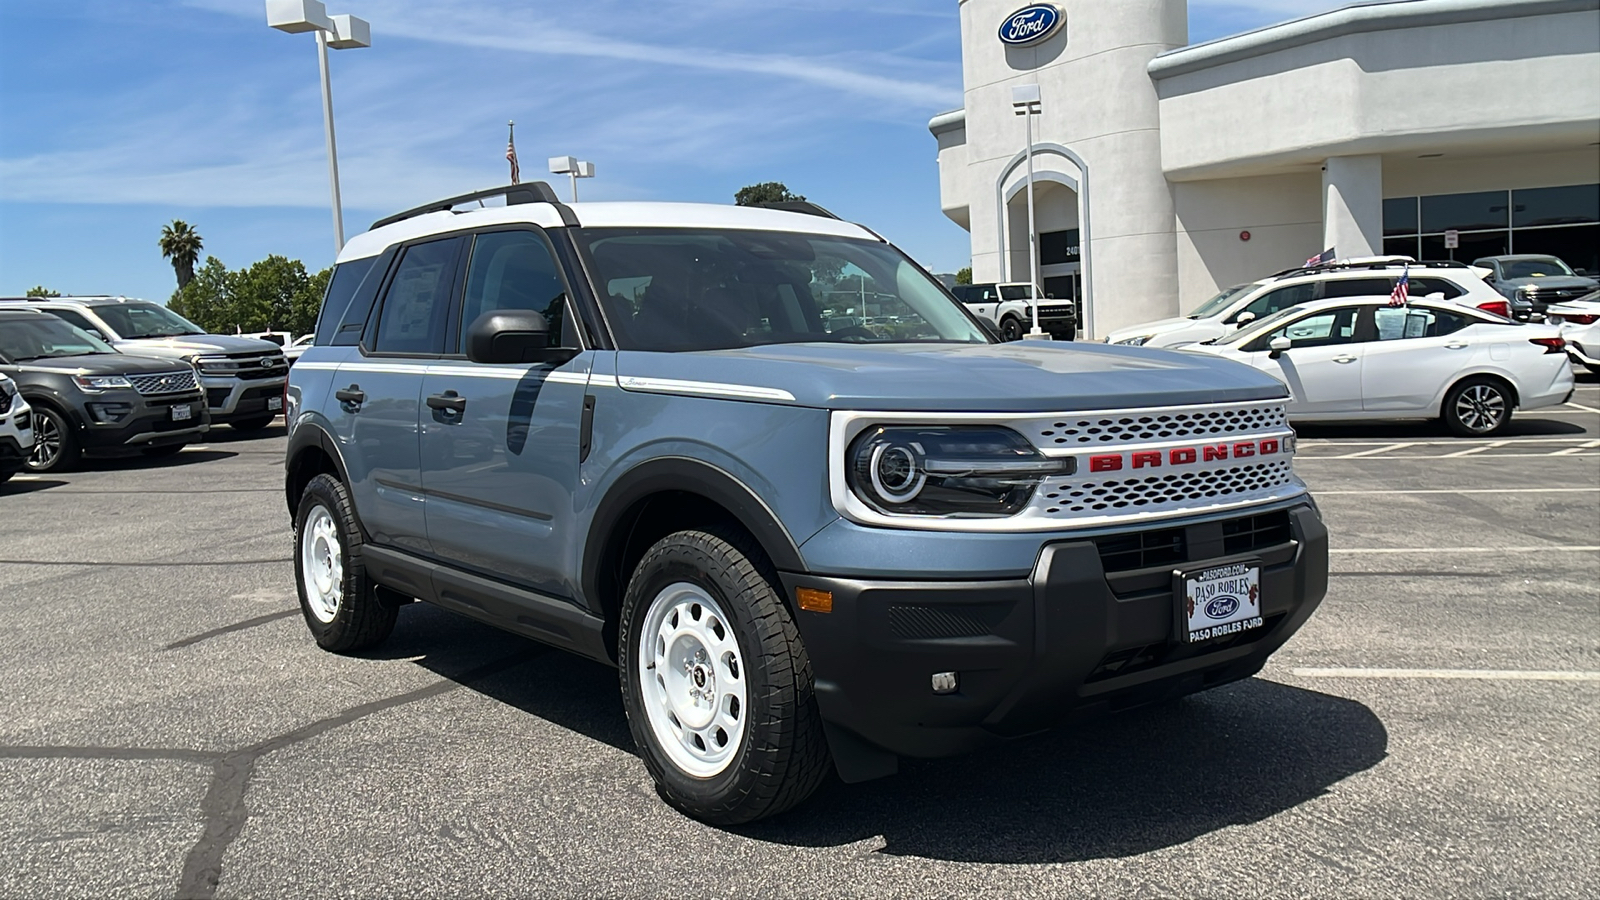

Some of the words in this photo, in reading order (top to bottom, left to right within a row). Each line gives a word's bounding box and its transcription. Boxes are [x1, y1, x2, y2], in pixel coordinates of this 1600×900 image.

[1009, 11, 1045, 39] Ford
[1089, 439, 1279, 473] BRONCO
[1203, 564, 1245, 580] PASOFORD.COM
[1195, 584, 1215, 606] PASO
[1218, 577, 1249, 596] ROBLES
[1211, 599, 1233, 615] Ford
[1189, 629, 1210, 643] PASO
[1212, 622, 1242, 637] ROBLES
[1243, 617, 1263, 630] FORD
